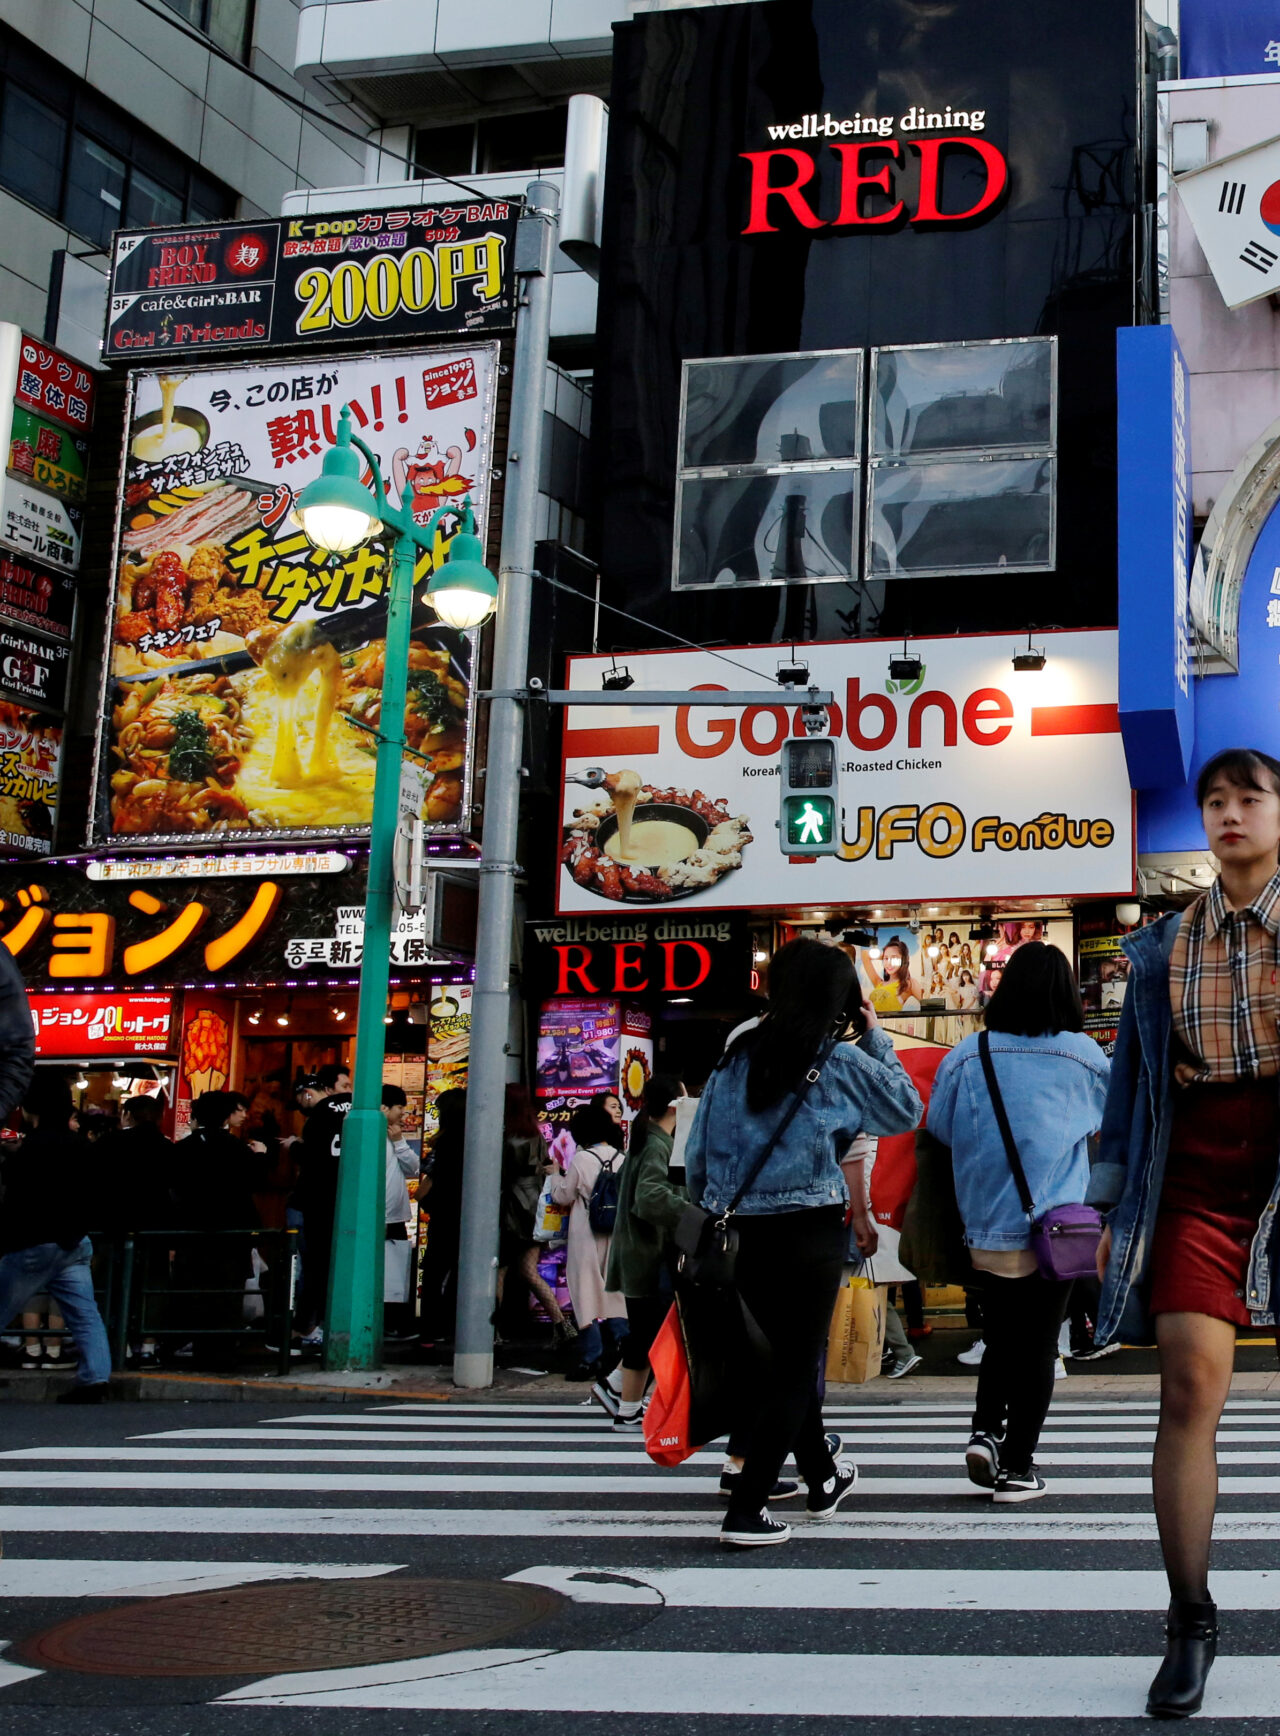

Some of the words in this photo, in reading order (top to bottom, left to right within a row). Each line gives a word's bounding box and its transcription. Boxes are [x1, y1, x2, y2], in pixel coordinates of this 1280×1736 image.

[767, 113, 893, 141] well-being
[900, 106, 985, 131] dining
[738, 136, 1007, 235] RED
[119, 240, 135, 252] 4F
[425, 226, 461, 242] 50分
[160, 244, 207, 268] BOY
[147, 263, 217, 288] FRIEND
[294, 231, 507, 336] 2000円
[113, 300, 129, 311] 3F
[114, 329, 155, 349] Girl
[172, 318, 265, 345] Friends
[25, 347, 35, 360] 7F
[40, 351, 90, 392] ソウル
[424, 360, 472, 381] since1995
[21, 371, 88, 422] 整体院
[209, 369, 339, 413] 今、この店が
[426, 369, 473, 402] ジョンノ
[151, 456, 250, 493] サムギョプサル
[69, 508, 81, 520] 5F
[228, 528, 330, 585] チー
[1, 559, 36, 589] BOY
[138, 618, 221, 652] チキンフェア
[56, 645, 70, 659] 3F
[17, 681, 47, 699] Friends
[846, 763, 892, 773] Roasted
[896, 759, 942, 771] Chicken
[837, 803, 965, 862] UFO
[972, 812, 1114, 853] Fondue
[534, 921, 648, 944] well-being
[654, 919, 731, 942] dining
[288, 942, 326, 966] 종로
[552, 941, 711, 995] RED
[659, 1436, 678, 1446] VAN
